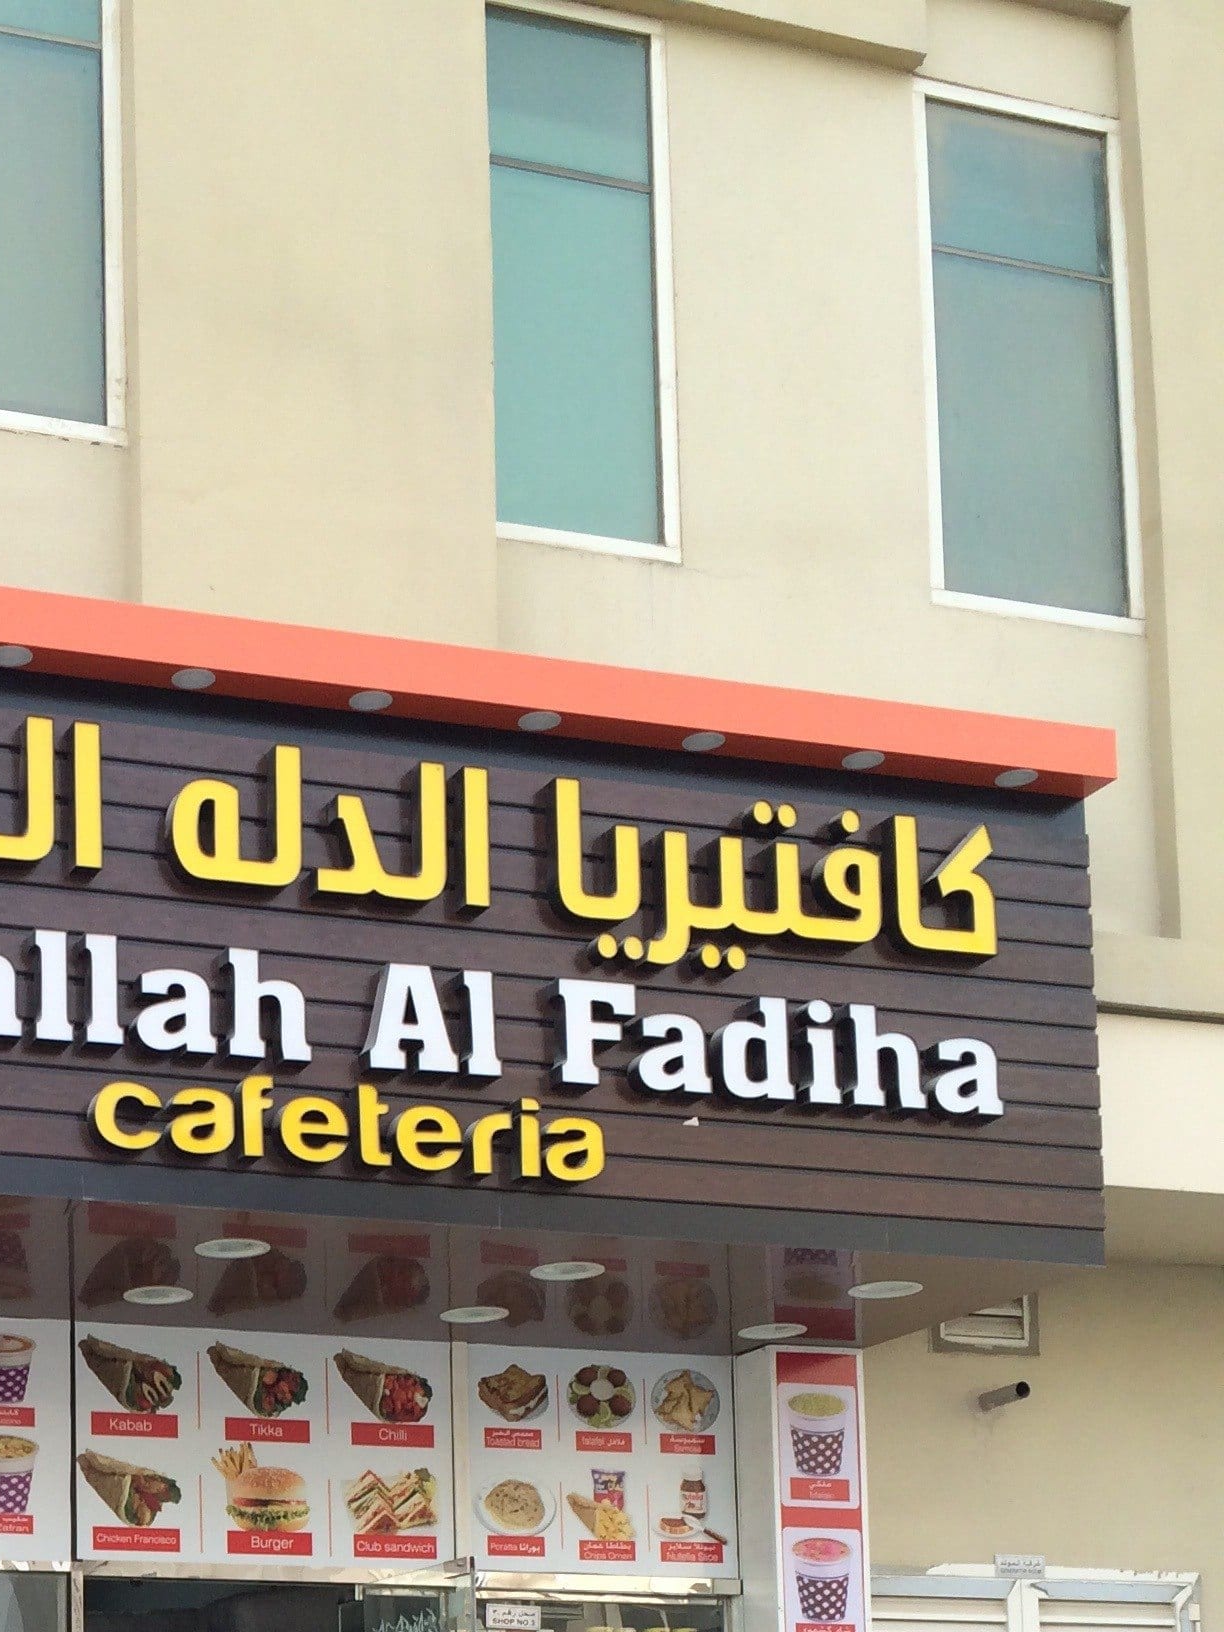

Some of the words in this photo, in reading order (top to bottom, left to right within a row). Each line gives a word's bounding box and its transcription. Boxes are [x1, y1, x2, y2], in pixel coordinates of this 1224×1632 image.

[170, 744, 491, 908] الدله
[555, 777, 999, 971] كافتيريا
[369, 962, 503, 1077] Al
[553, 977, 1004, 1117] Fadiha
[93, 1074, 607, 1182] cafeteria
[109, 1418, 154, 1432] Kabab
[248, 1423, 284, 1437] Tikka
[378, 1428, 408, 1442] Chilli
[95, 1533, 133, 1545] Chicken
[250, 1536, 295, 1553] Burger
[355, 1540, 383, 1553] Club
[384, 1541, 435, 1555] sandwich
[491, 1617, 515, 1626] SHOP
